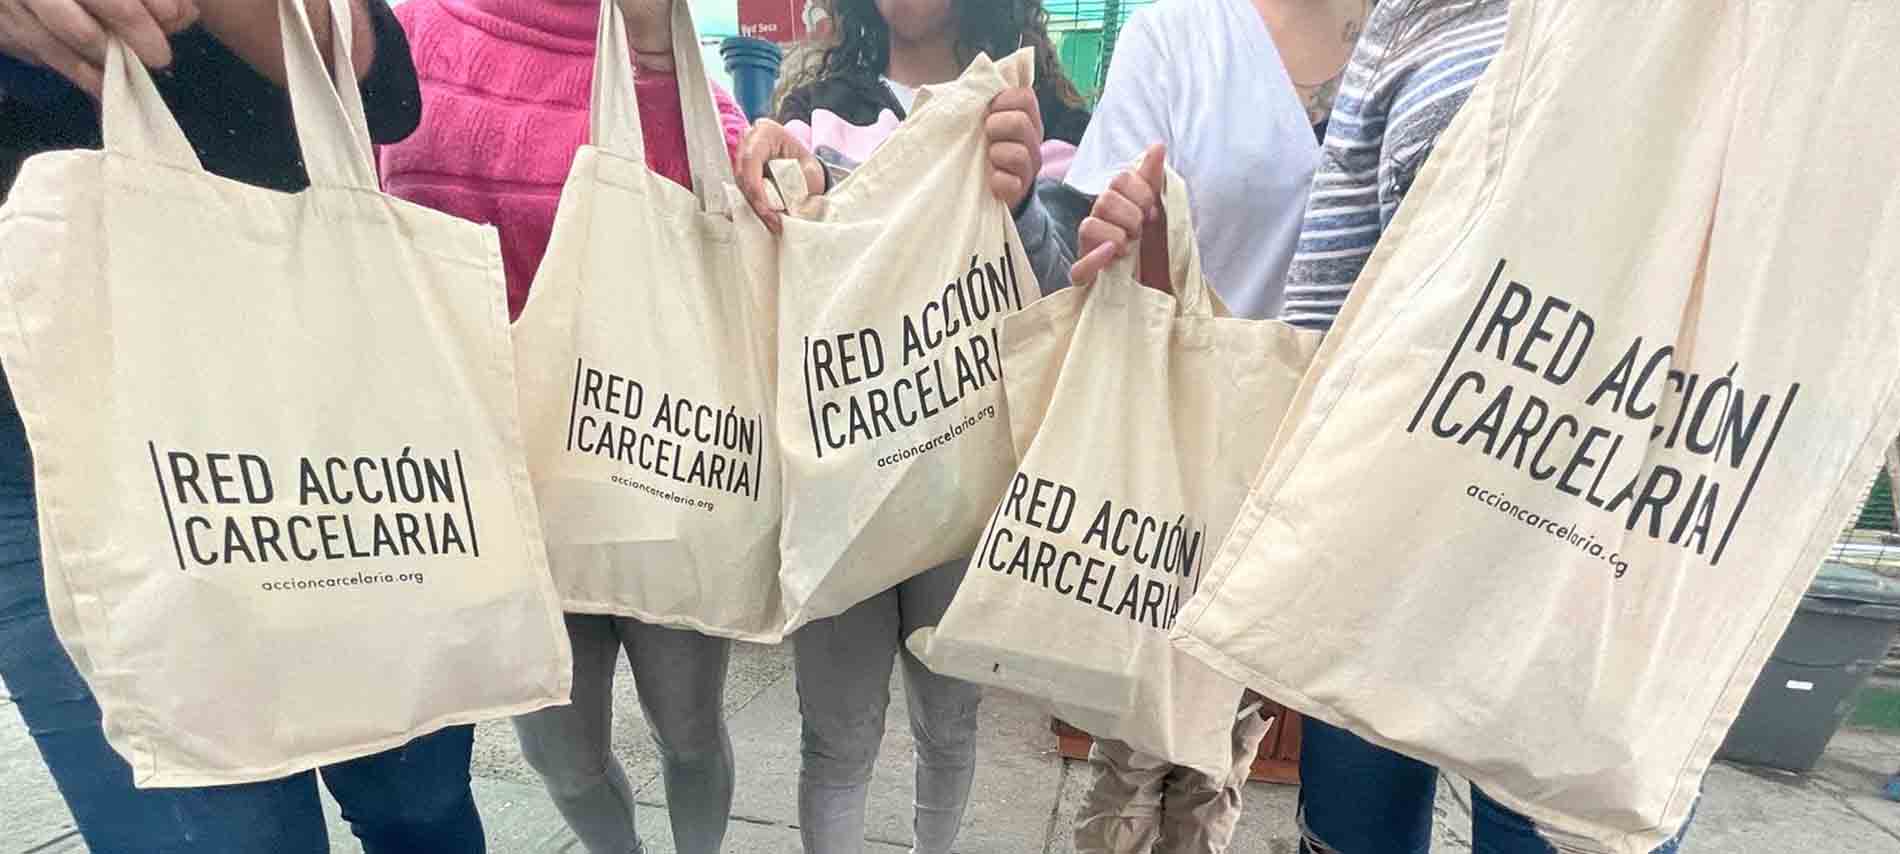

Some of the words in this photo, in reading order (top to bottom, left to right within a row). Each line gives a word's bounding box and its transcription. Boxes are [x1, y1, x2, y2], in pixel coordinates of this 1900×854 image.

[812, 328, 885, 391] RED
[903, 254, 1010, 366] ACCIÓN
[1475, 280, 1596, 386] RED
[583, 368, 644, 420] RED
[652, 393, 755, 455] ACCIÓN
[822, 328, 1004, 449] CARCELARI
[167, 451, 274, 505] RED
[299, 446, 456, 506] ACCIÓN
[577, 415, 750, 497] CARCELARIA
[877, 403, 995, 468] accioncarcelaria.org
[611, 474, 715, 512] accioncarcelaria.org
[1004, 471, 1077, 534] RED
[1081, 500, 1201, 578] ACCIÓN
[184, 512, 467, 566] CARCELARIA
[988, 527, 1181, 630] CARCELARIA
[261, 571, 425, 592] accioncarcelaria.org
